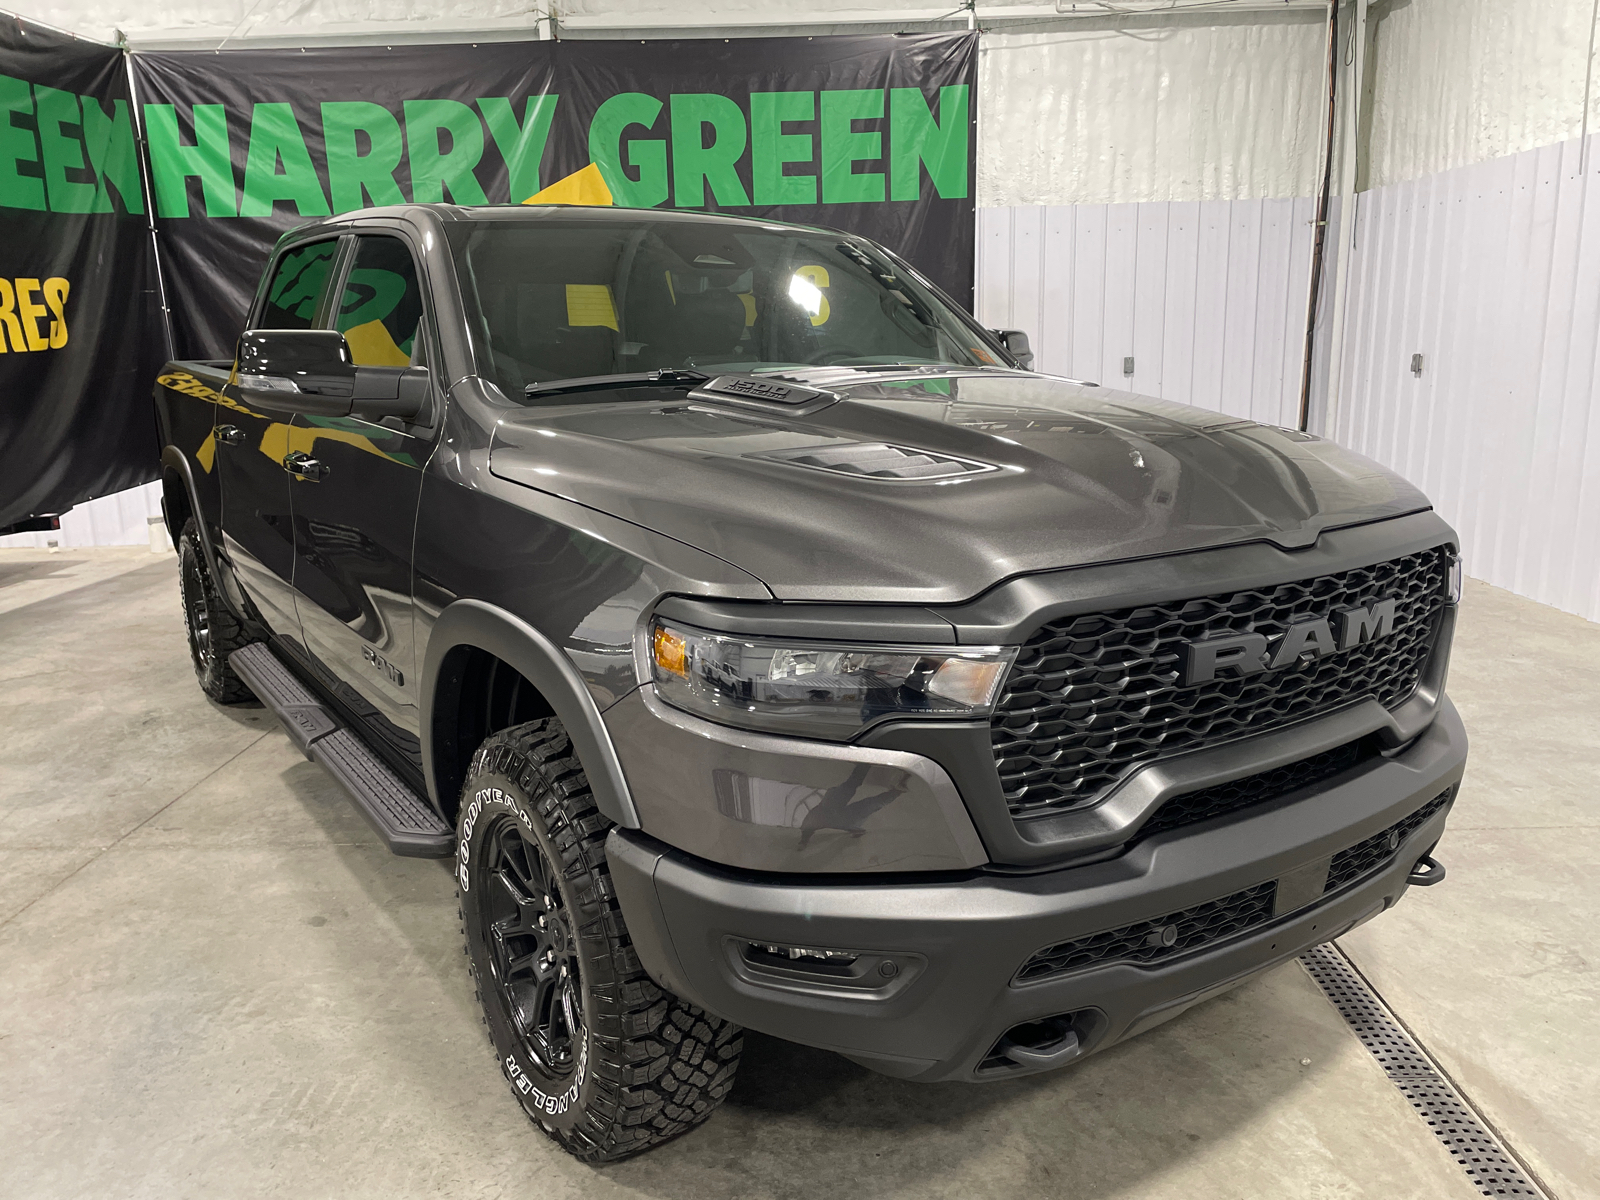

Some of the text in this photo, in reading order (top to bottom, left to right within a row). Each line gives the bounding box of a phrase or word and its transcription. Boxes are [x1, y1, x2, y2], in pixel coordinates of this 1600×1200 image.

[144, 84, 969, 218] HARRY GREEN
[730, 379, 792, 398] 1500
[361, 644, 404, 687] RAM
[1186, 598, 1396, 686] RAM
[460, 788, 533, 892] GOODYEAR
[505, 1023, 589, 1115] WRANGLER
